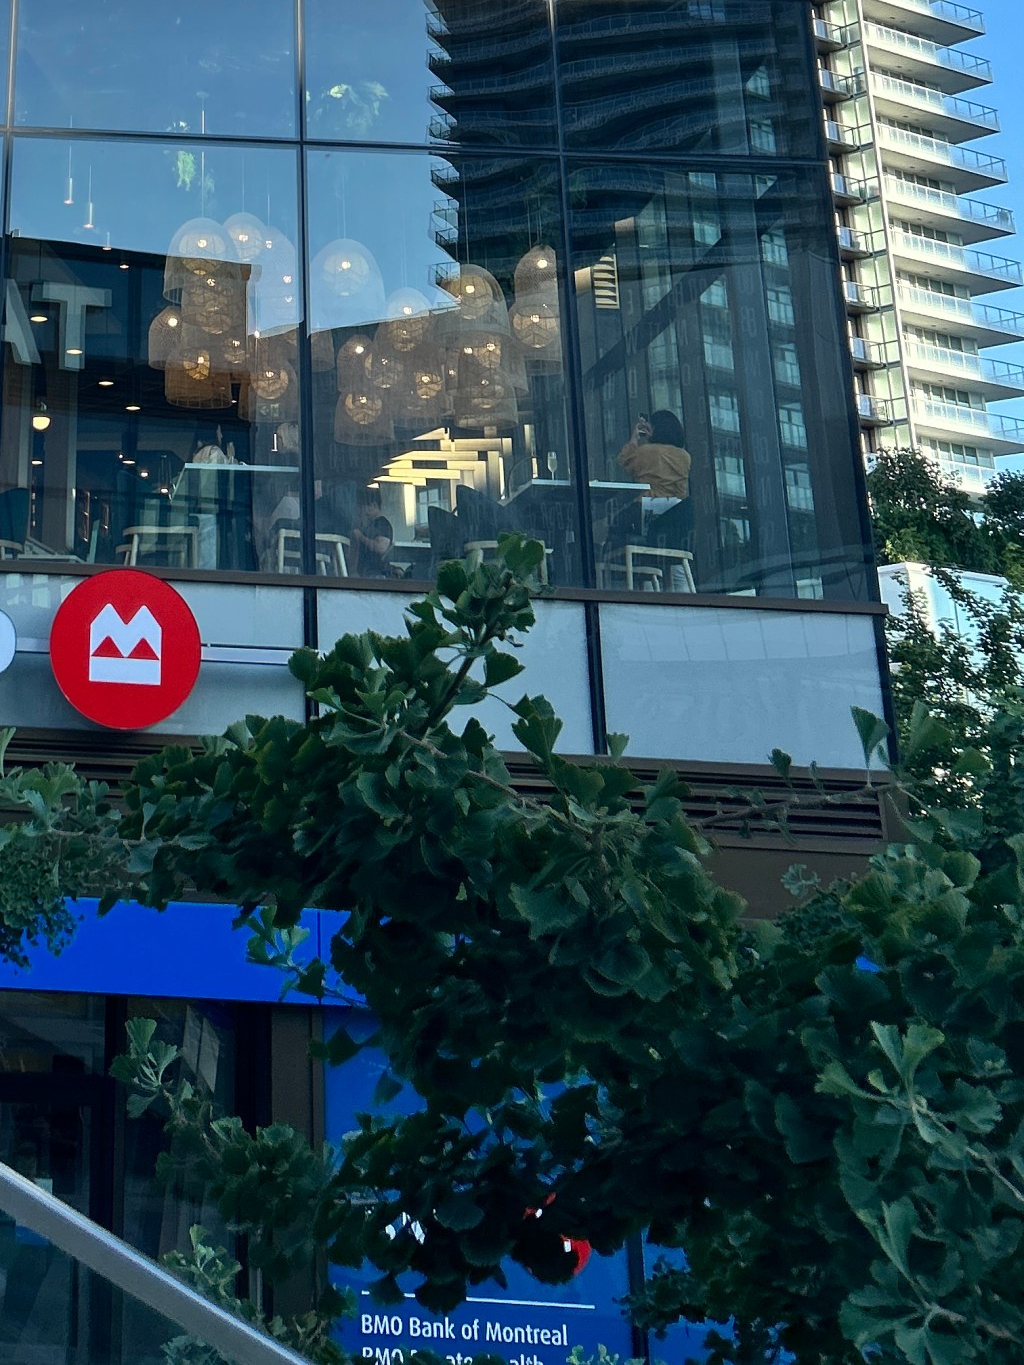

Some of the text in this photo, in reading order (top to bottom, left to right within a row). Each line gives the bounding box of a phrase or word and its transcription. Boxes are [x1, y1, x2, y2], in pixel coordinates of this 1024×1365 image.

[361, 1313, 569, 1346] BMO Bank of Montreal
